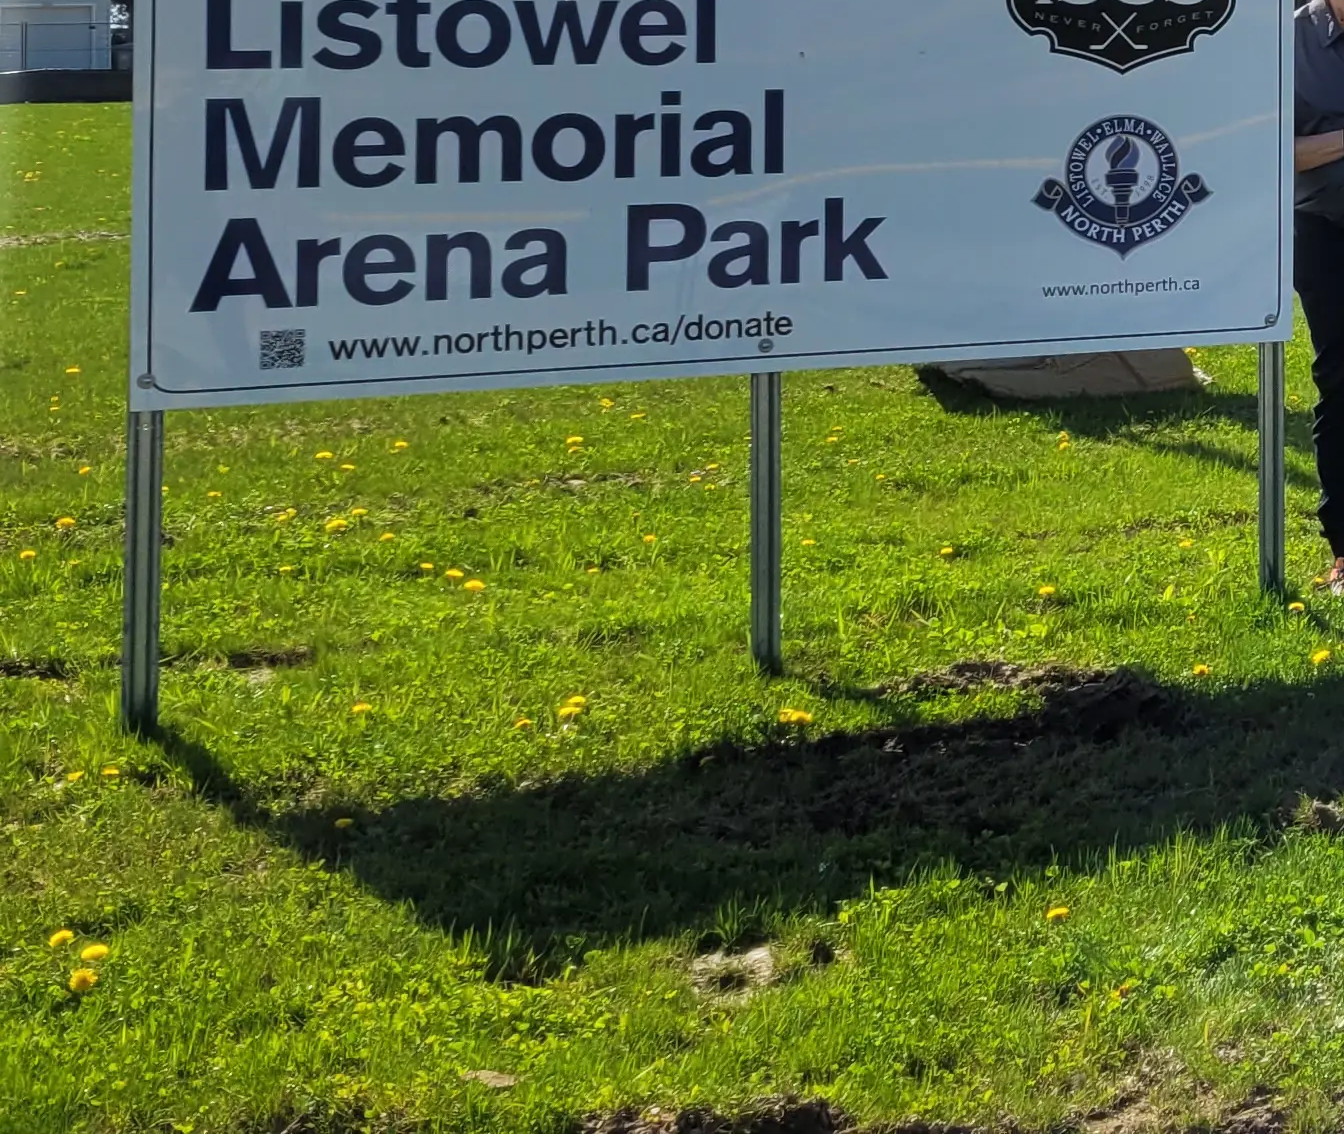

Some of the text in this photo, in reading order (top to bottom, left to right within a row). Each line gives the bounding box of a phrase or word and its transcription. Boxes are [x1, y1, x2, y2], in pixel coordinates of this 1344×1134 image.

[1035, 10, 1213, 33] NEVER FORGET
[204, 89, 785, 191] Memorial
[1069, 119, 1176, 207] LISTOWEL ELMA WALLACE
[1060, 200, 1185, 243] NORTH PERTH
[189, 198, 889, 312] Arena Park
[1042, 277, 1200, 297] www.northperth.ca
[328, 310, 793, 361] www.northperth.ca/donate
